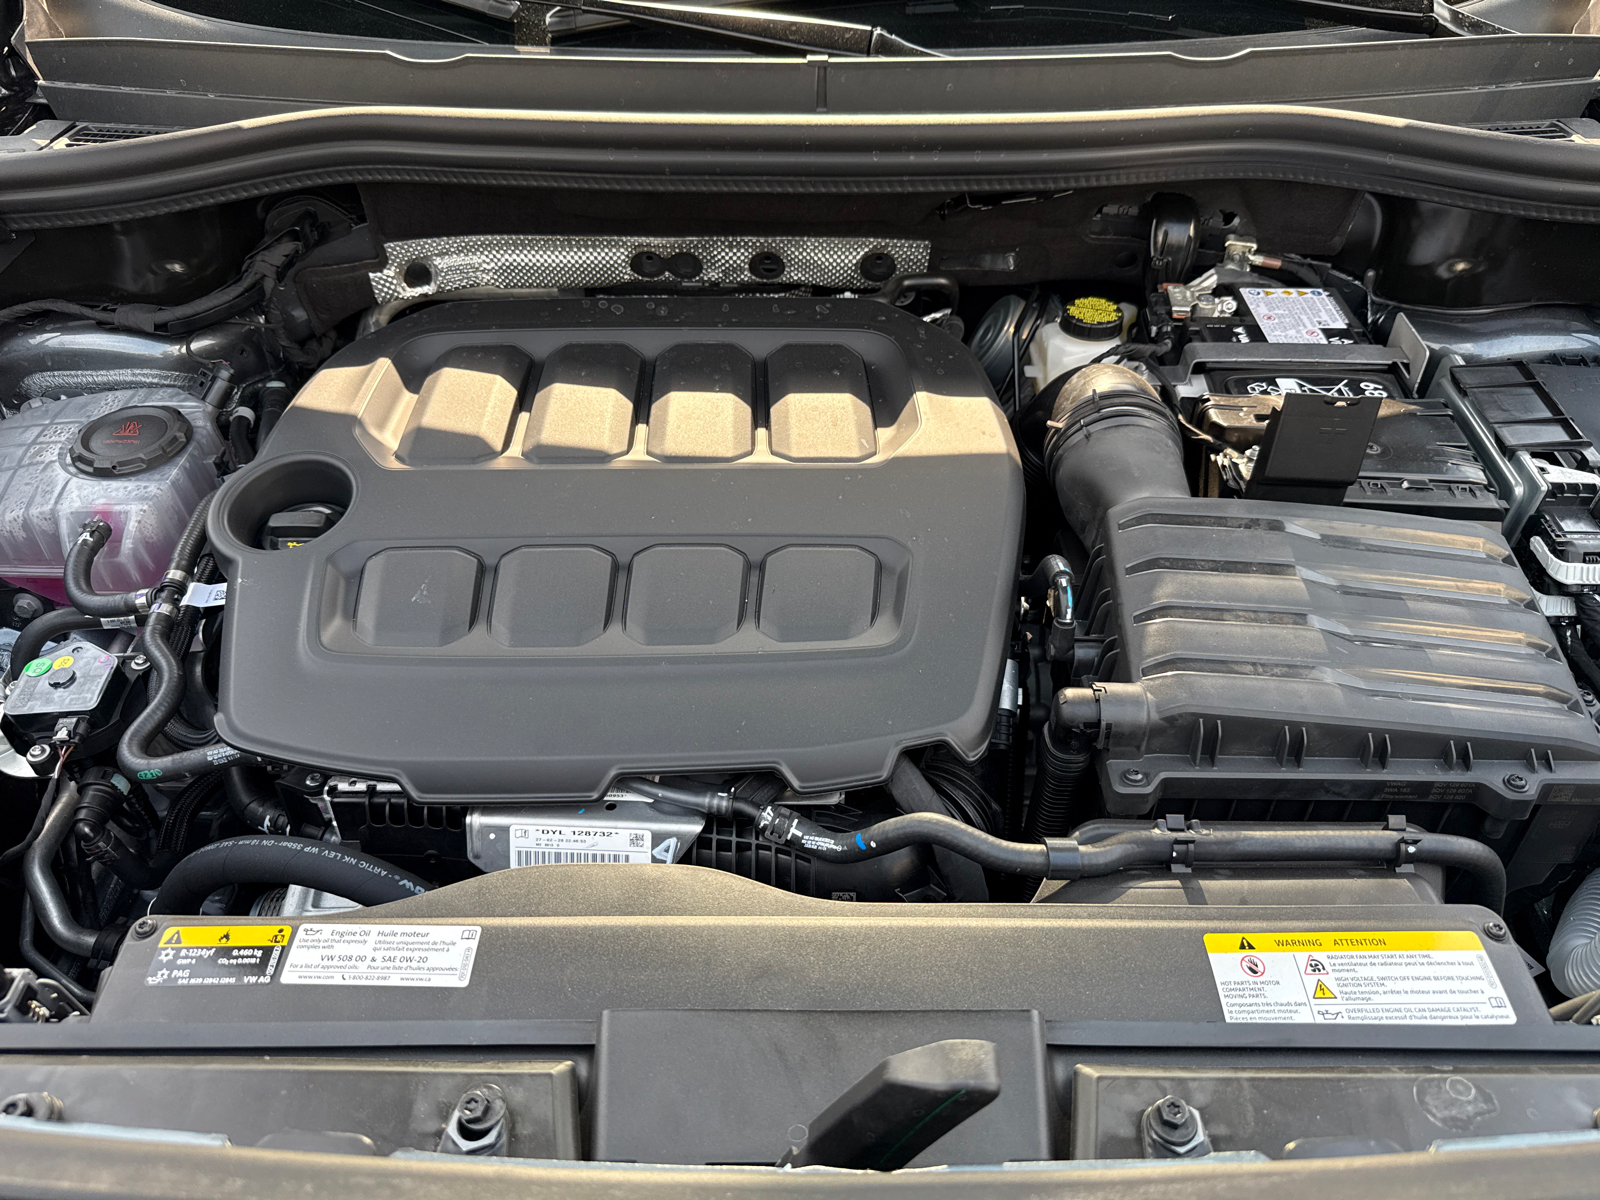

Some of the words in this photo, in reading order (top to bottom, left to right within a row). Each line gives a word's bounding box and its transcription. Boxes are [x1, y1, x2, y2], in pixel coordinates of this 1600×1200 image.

[331, 929, 358, 938] Engine
[1274, 938, 1322, 947] WARNING
[1333, 938, 1386, 946] ATTENTION
[232, 948, 253, 956] 0.460
[253, 948, 263, 958] kg
[320, 954, 337, 962] VW
[337, 954, 354, 962] 508
[354, 954, 367, 962] 00
[398, 956, 428, 964] 0W-20
[172, 970, 191, 978] PAG
[243, 976, 258, 984] VW
[258, 976, 272, 984] AG
